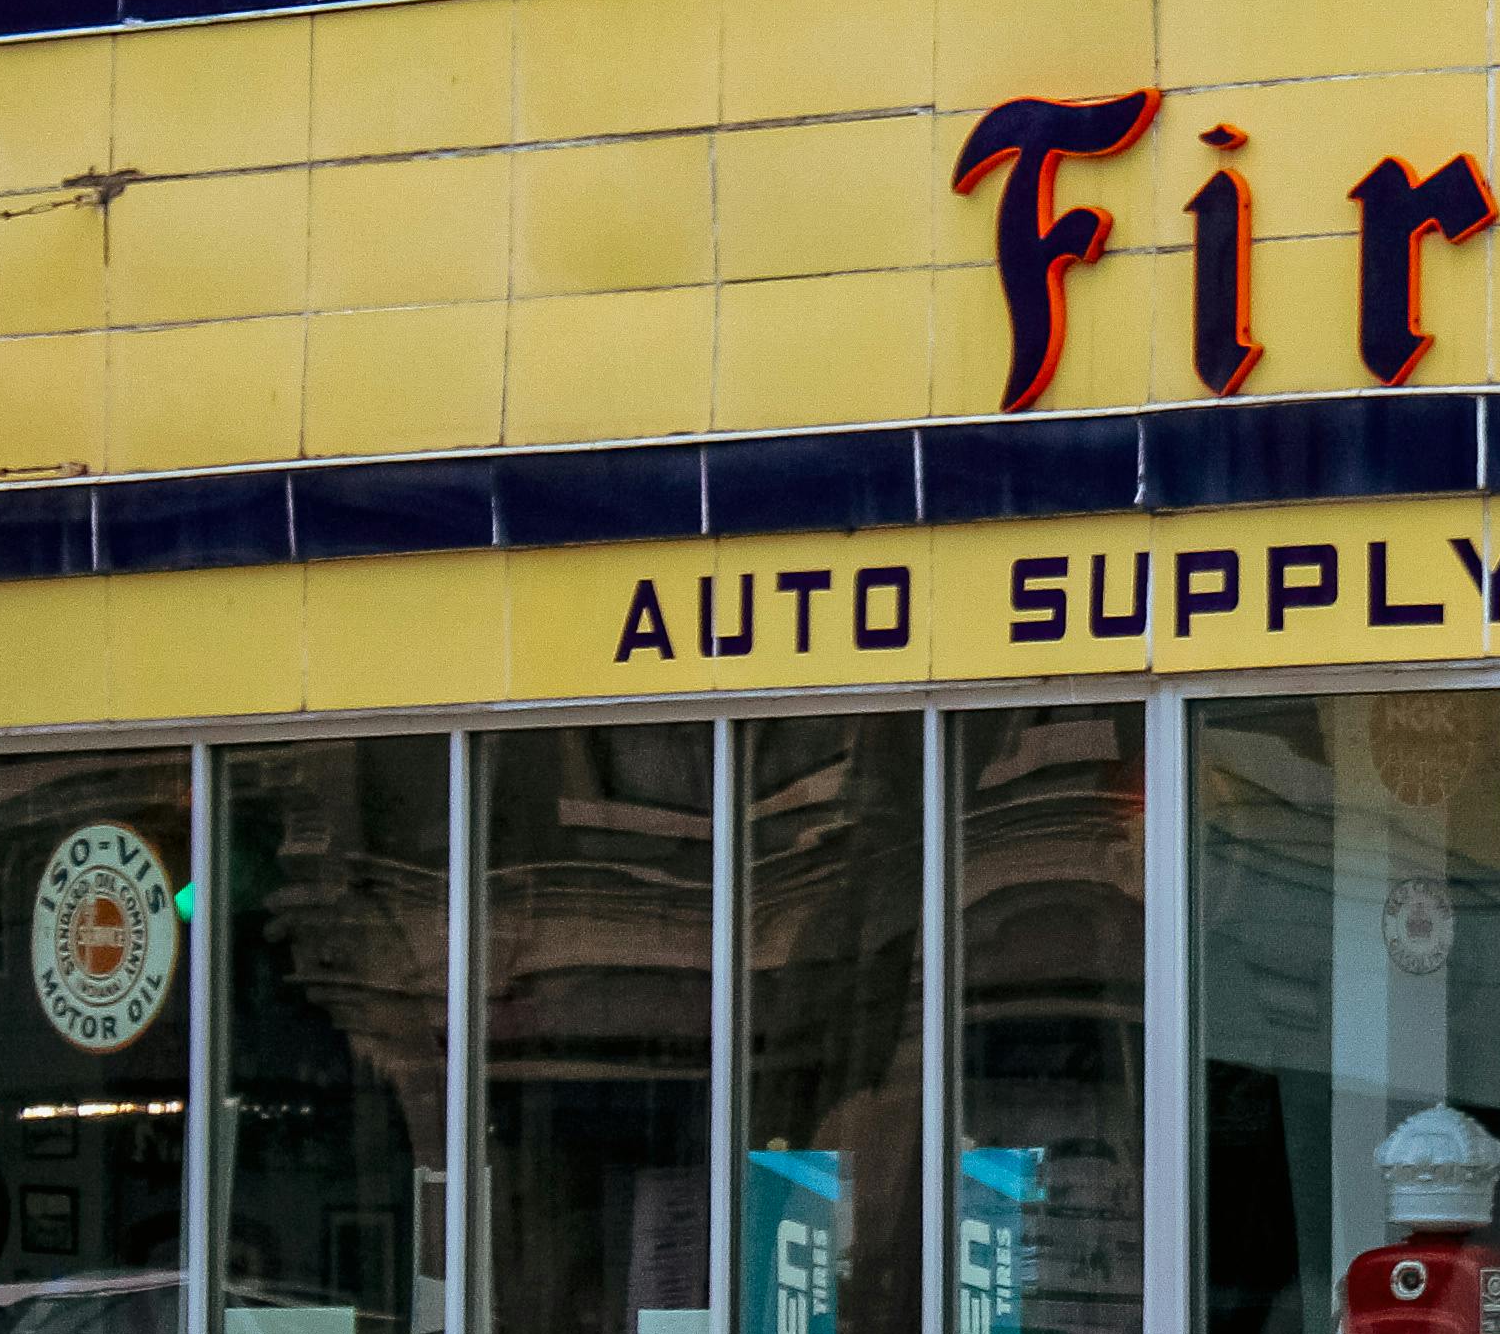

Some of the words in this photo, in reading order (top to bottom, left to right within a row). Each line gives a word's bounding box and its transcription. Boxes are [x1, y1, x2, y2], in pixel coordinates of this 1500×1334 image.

[613, 565, 911, 664] AUTO
[41, 968, 117, 1040] MOTOR
[129, 973, 163, 1023] OIL
[997, 1226, 1013, 1316] TIRES
